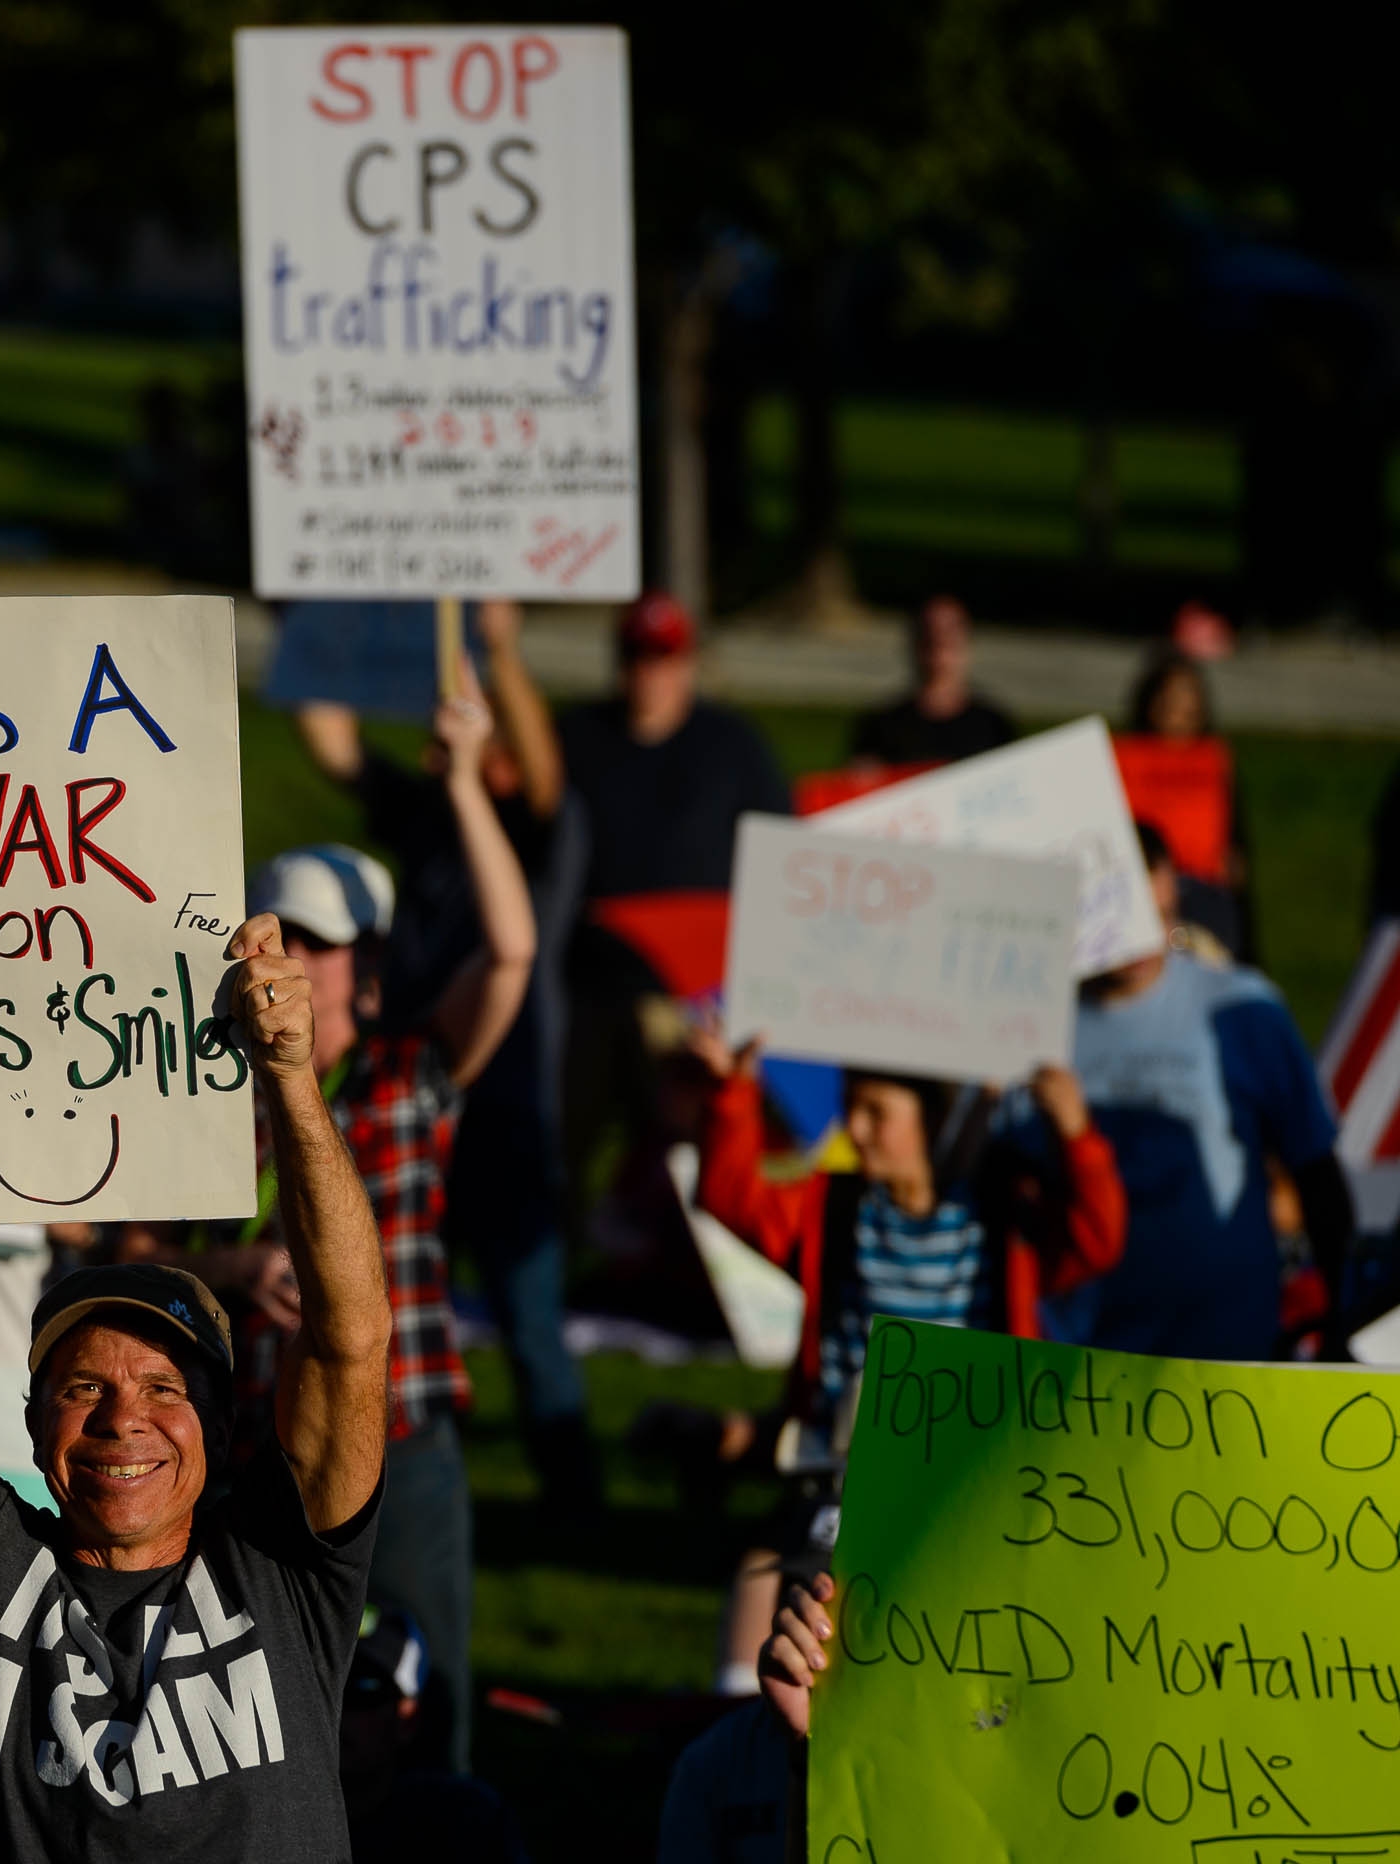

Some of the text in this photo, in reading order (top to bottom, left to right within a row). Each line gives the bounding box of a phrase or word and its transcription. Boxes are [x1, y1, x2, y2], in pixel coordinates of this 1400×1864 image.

[310, 36, 559, 122] STOP
[346, 138, 541, 238] CPS
[269, 240, 613, 389] trafficking
[69, 643, 177, 753] A
[173, 893, 230, 937] Free
[784, 849, 936, 925] STOP
[68, 952, 249, 1097] Smiles
[874, 1322, 1400, 1471] Population O
[1004, 1466, 1400, 1590] 331,000,0
[839, 1572, 1400, 1751] COVID Mortality
[36, 1648, 285, 1807] SCAM
[1057, 1733, 1310, 1829] 0.04%
